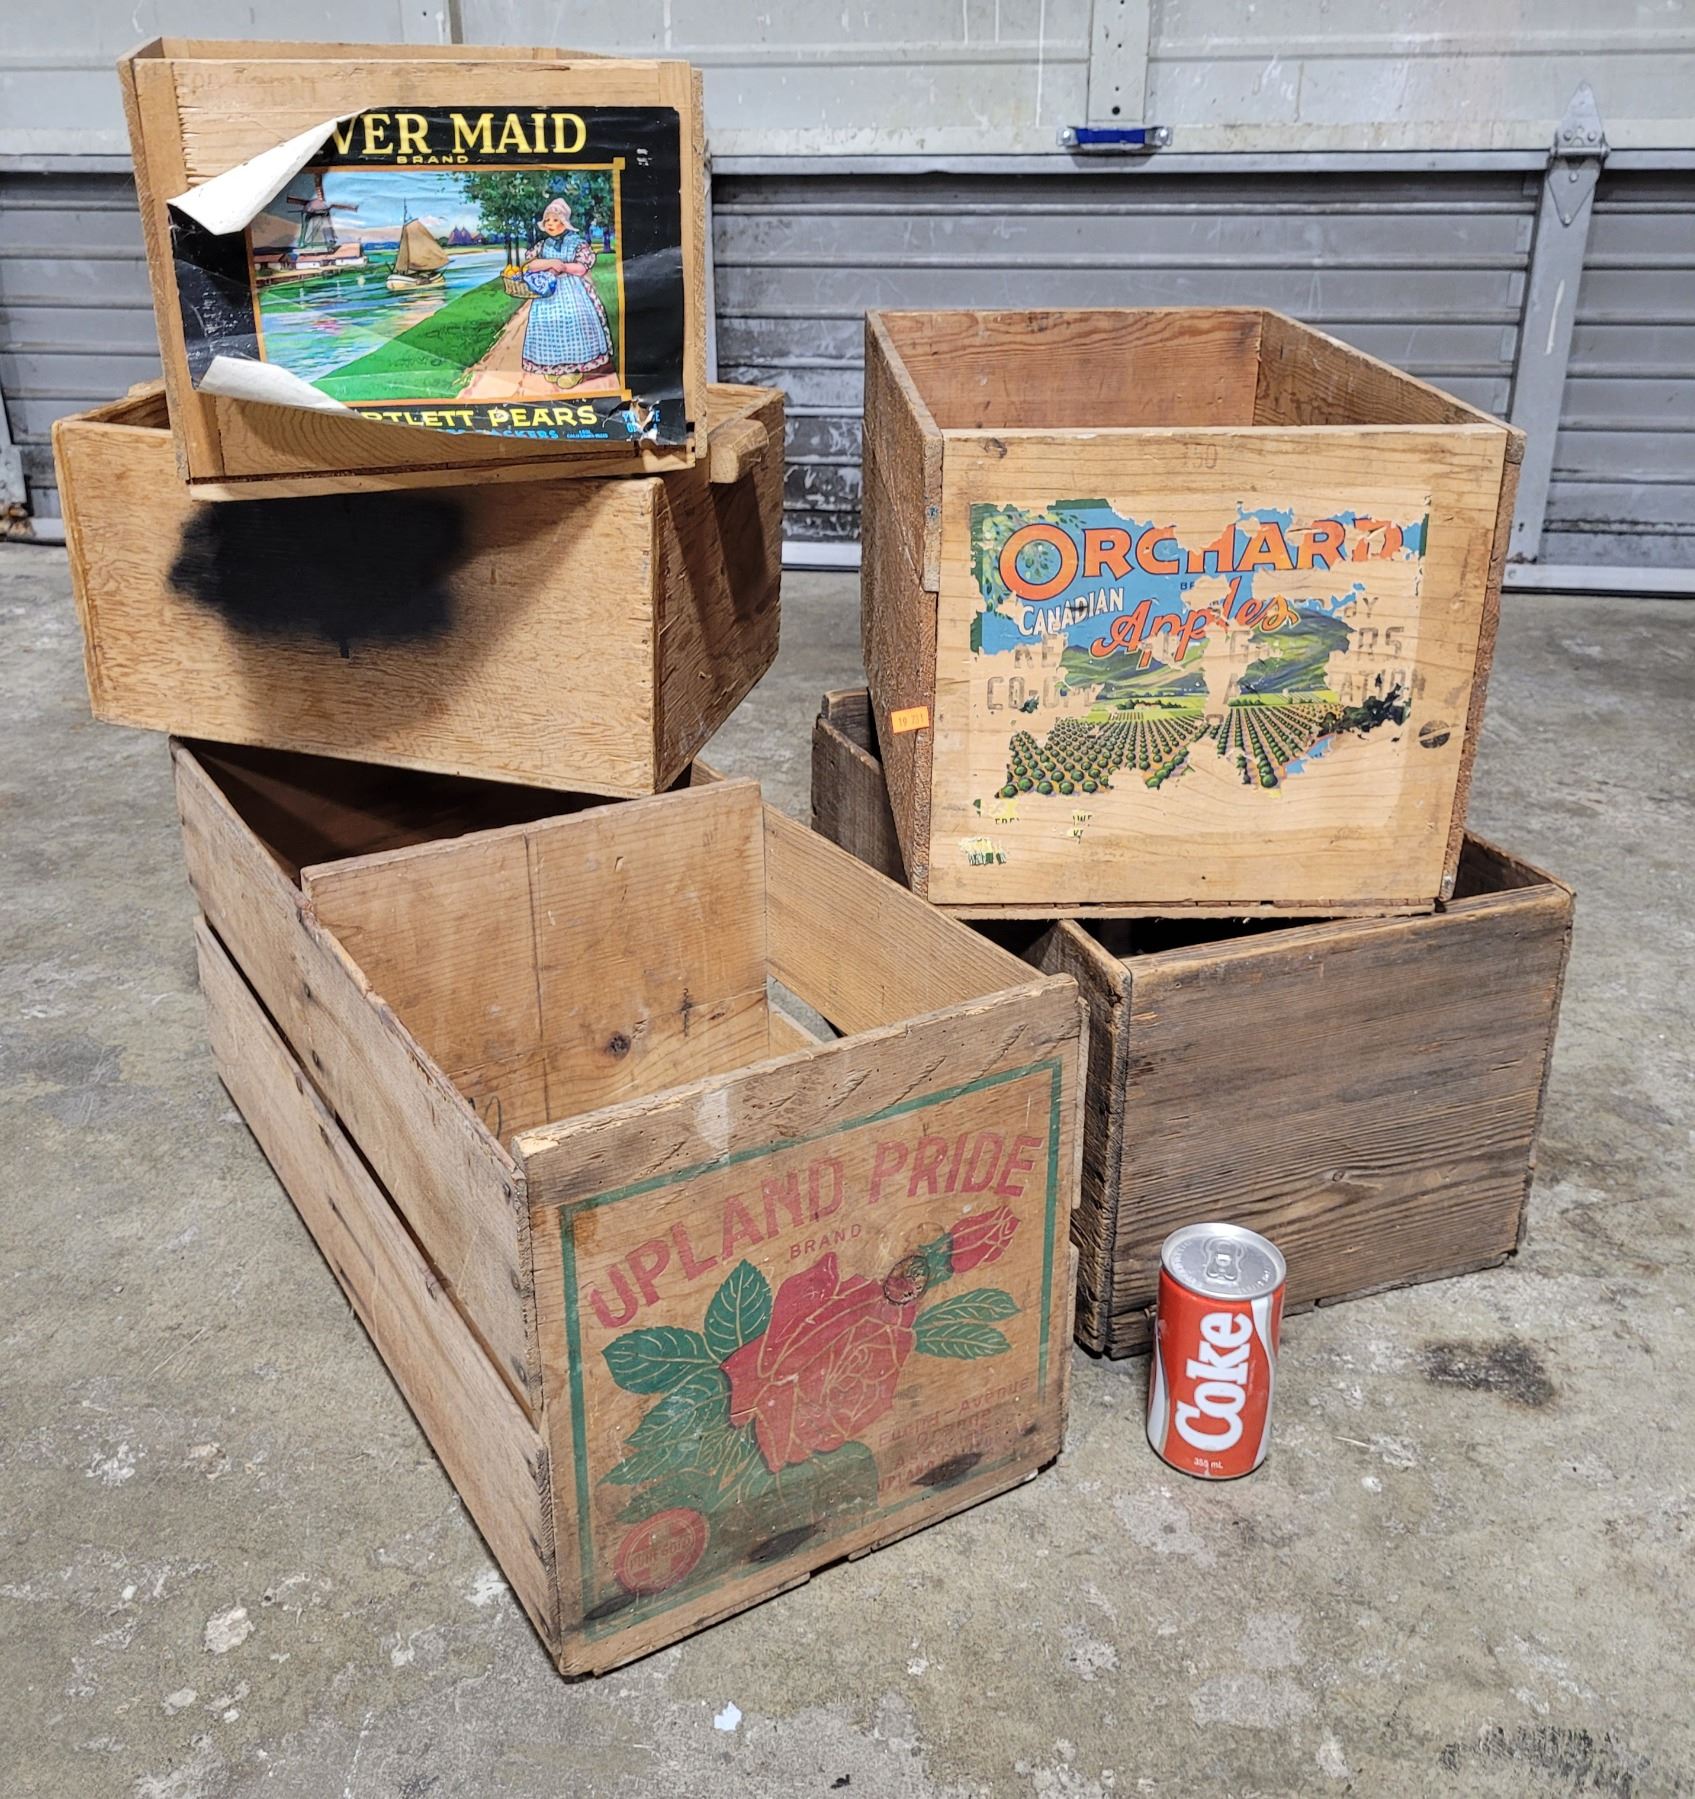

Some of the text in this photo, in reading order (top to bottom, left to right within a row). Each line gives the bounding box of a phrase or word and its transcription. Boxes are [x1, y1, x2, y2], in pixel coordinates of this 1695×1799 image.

[450, 113, 587, 154] MAID
[396, 155, 469, 164] BRAND
[487, 404, 598, 427] PEARS
[1018, 587, 1124, 637] CANADIAN
[1089, 577, 1299, 671] Apples
[589, 1131, 1044, 1329] UPLAND PRIDE
[789, 1223, 862, 1260] BRAND
[1175, 1311, 1253, 1452] Coke
